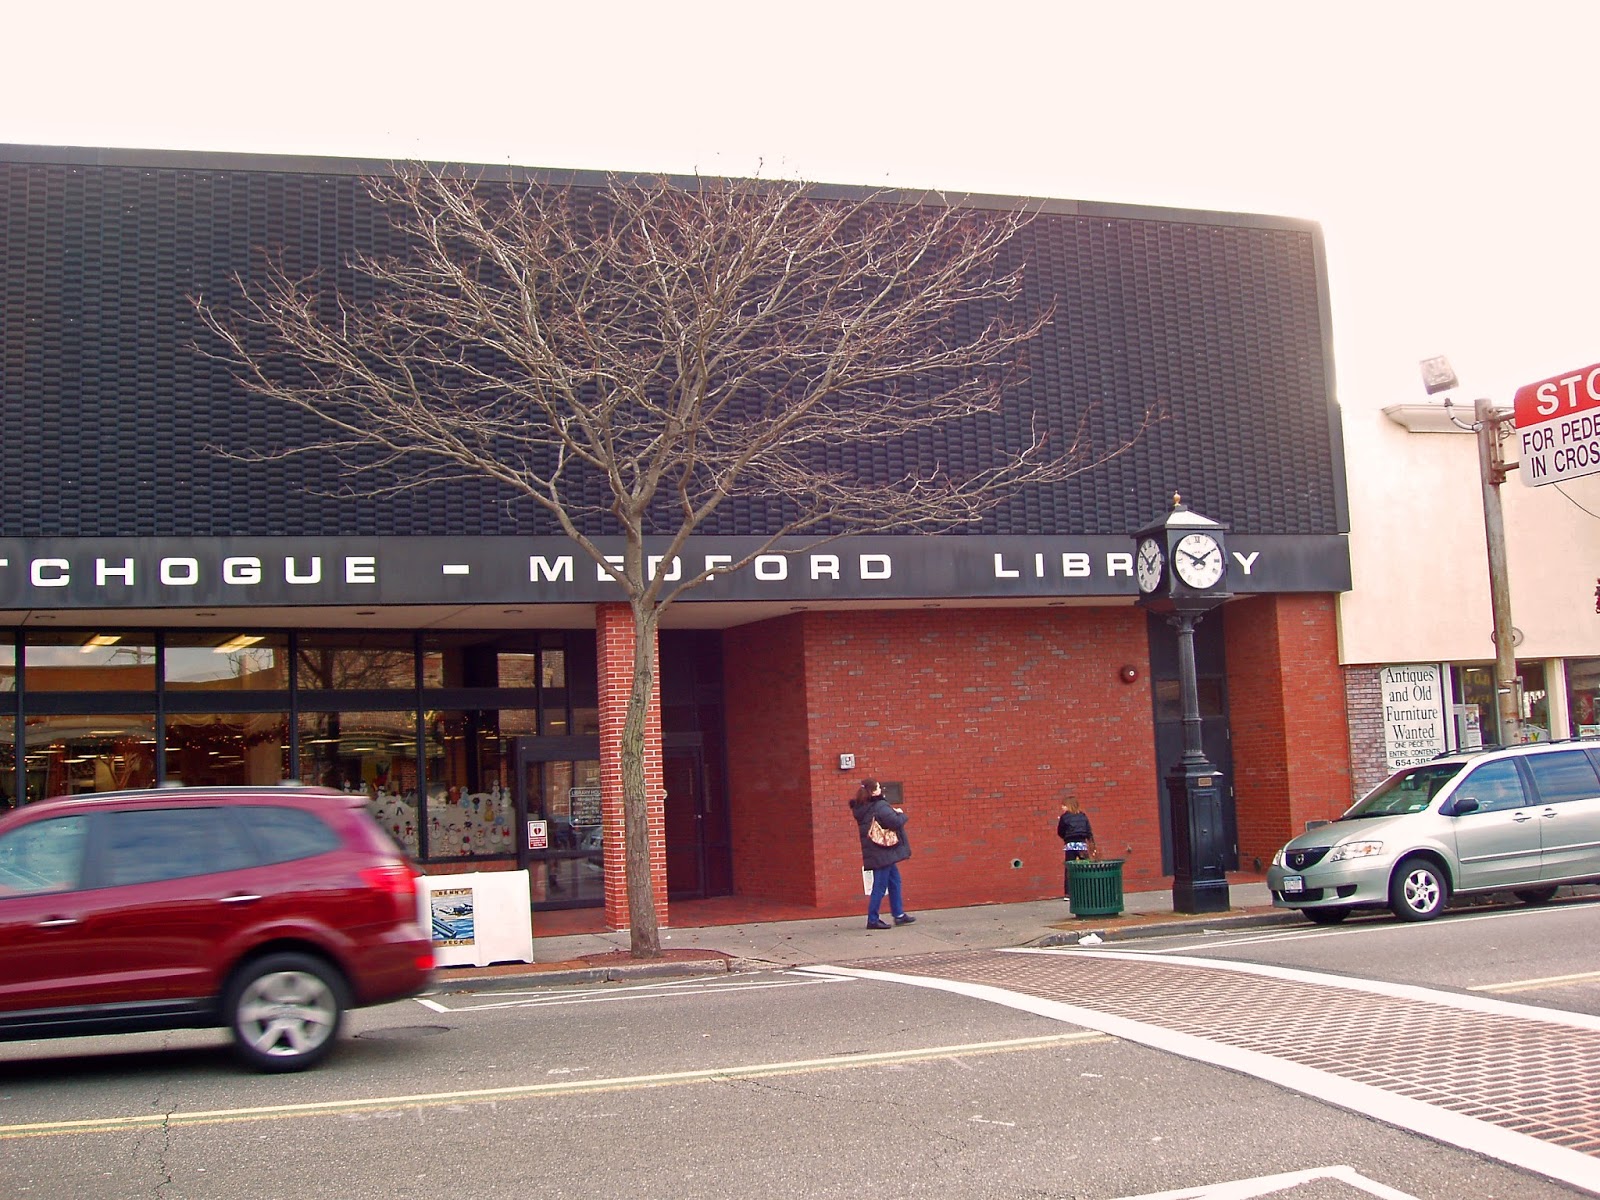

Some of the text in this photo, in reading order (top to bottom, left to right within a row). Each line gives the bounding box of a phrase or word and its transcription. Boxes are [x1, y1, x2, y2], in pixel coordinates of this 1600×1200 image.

[1522, 427, 1555, 455] FOR
[1531, 441, 1600, 478] IN CROS
[0, 556, 376, 587] CHOGUE
[529, 554, 892, 582] MEDFORD
[994, 551, 1260, 578] LIBRY
[1385, 667, 1435, 685] Antiques
[1389, 685, 1432, 702] and Old
[1386, 705, 1438, 721] Furniture
[1392, 723, 1435, 740] Wanted
[1410, 748, 1441, 756] CONTENTS
